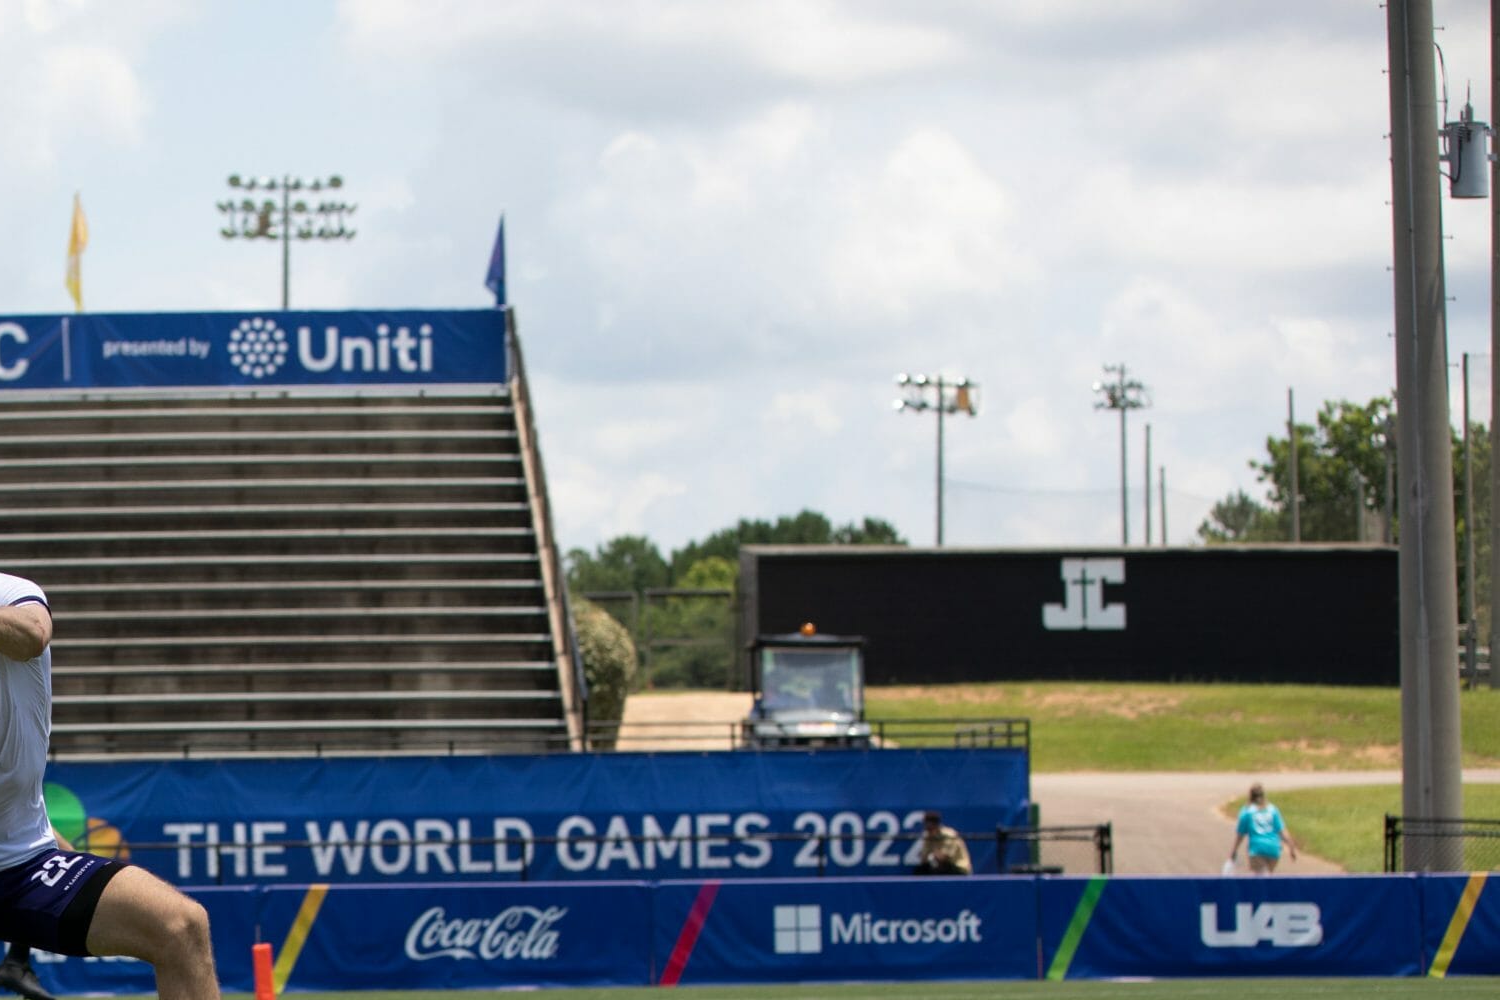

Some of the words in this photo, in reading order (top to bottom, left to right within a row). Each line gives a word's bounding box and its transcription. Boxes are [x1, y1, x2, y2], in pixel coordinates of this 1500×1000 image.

[102, 338, 186, 359] presented
[188, 337, 211, 359] by
[297, 323, 433, 372] Uniti
[163, 821, 288, 877] THE
[306, 817, 534, 875] WORLD
[556, 813, 773, 871] GAMES
[31, 855, 83, 887] 22
[830, 909, 982, 944] Microsoft
[1200, 902, 1323, 947] UAB
